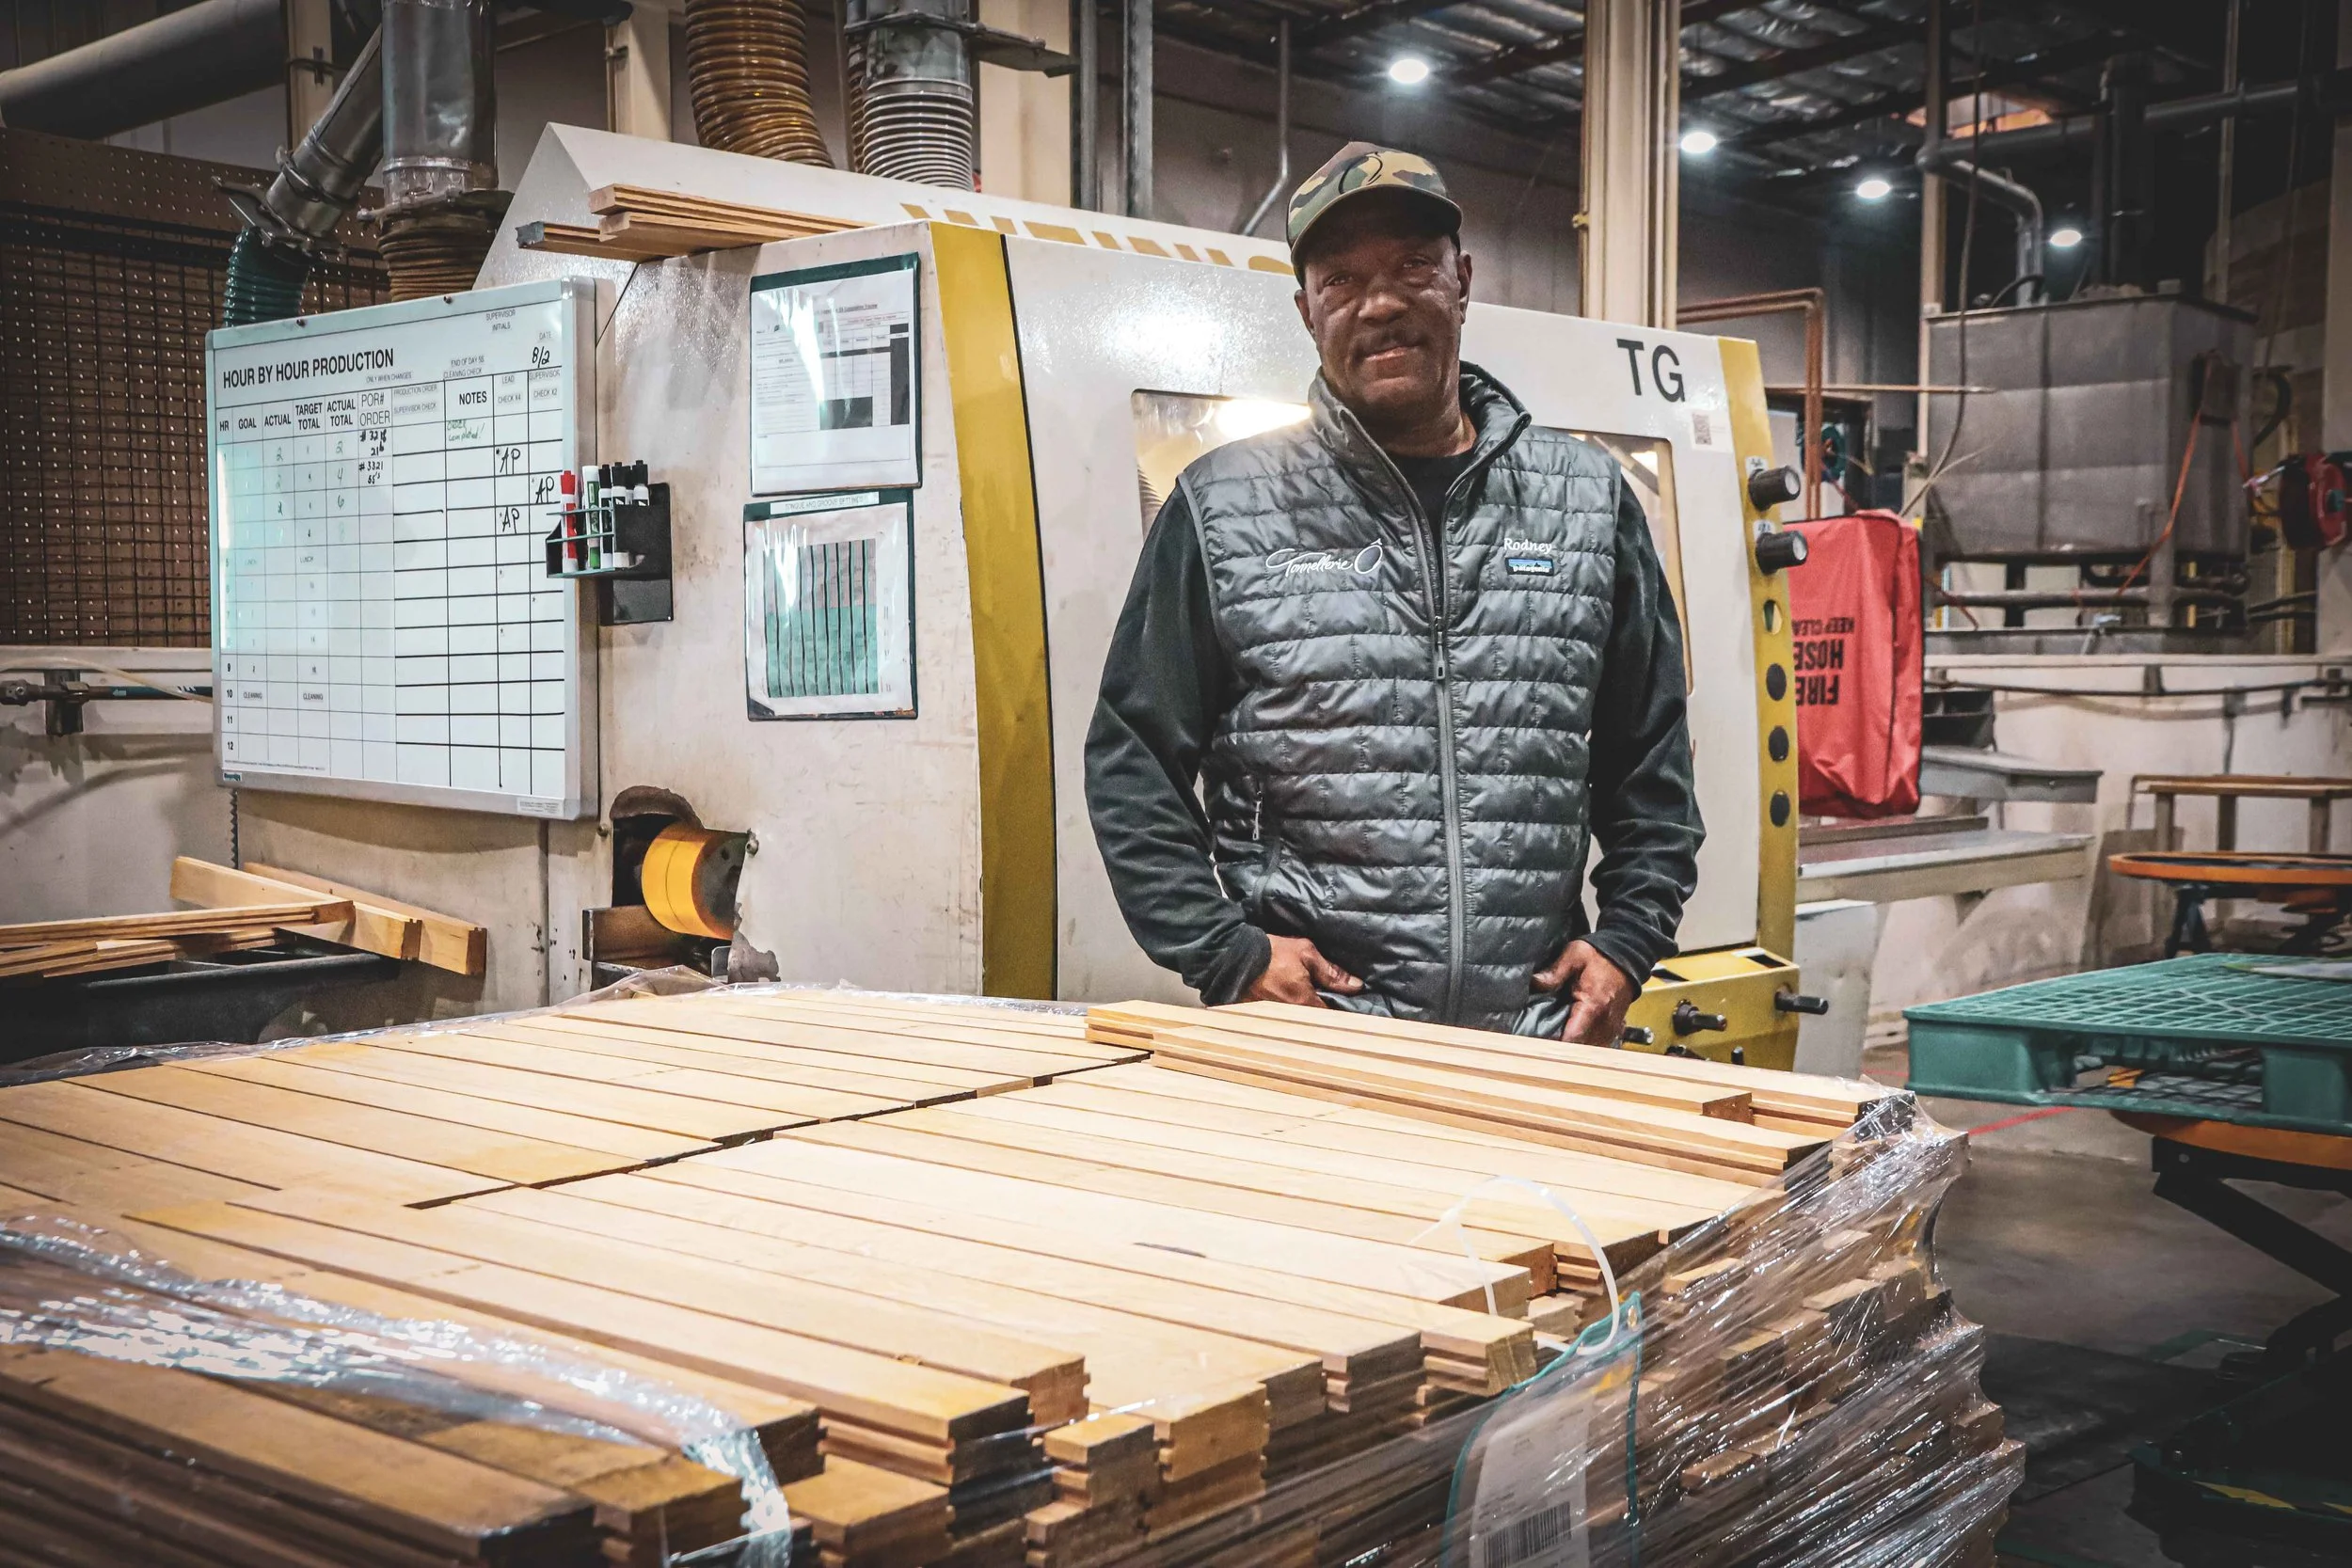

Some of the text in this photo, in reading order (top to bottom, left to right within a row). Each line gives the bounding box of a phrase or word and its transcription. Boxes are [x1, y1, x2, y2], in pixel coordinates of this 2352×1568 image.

[485, 309, 516, 321] SUPERVISOR
[492, 322, 511, 332] INITIALS
[539, 331, 552, 341] DATE
[532, 346, 550, 368] 8/2
[223, 348, 394, 388] HOUR BY HOUR PRODUCTION
[467, 368, 482, 376] CHECK
[1616, 338, 1685, 403] TG
[378, 373, 390, 383] WHEN
[391, 372, 412, 381] CHANGES
[501, 375, 515, 385] LEAD
[529, 370, 561, 381] SUPERVISOR
[394, 384, 437, 397] PRODUCTION ORDER
[533, 388, 550, 399] CHECK
[361, 391, 385, 407] POR#
[459, 391, 487, 405] NOTES
[498, 395, 515, 404] CHECK
[295, 403, 324, 416] TARGET
[327, 399, 356, 413] ACTUAL
[421, 402, 437, 411] CHECK
[238, 417, 257, 430] GOAL
[263, 414, 292, 427] ACTUAL
[298, 418, 321, 431] TOTAL
[330, 414, 353, 427] TOTAL
[359, 410, 390, 426] ORDER
[219, 420, 230, 432] HR
[501, 506, 519, 534] AP
[1503, 537, 1552, 555] Rodney
[1791, 617, 1854, 636] KEEP CLEA
[1793, 640, 1844, 671] HOSE
[227, 662, 231, 673] 9
[226, 689, 233, 699] 10
[1795, 674, 1839, 706] FIRE
[227, 715, 233, 724] 11
[227, 741, 233, 751] 12
